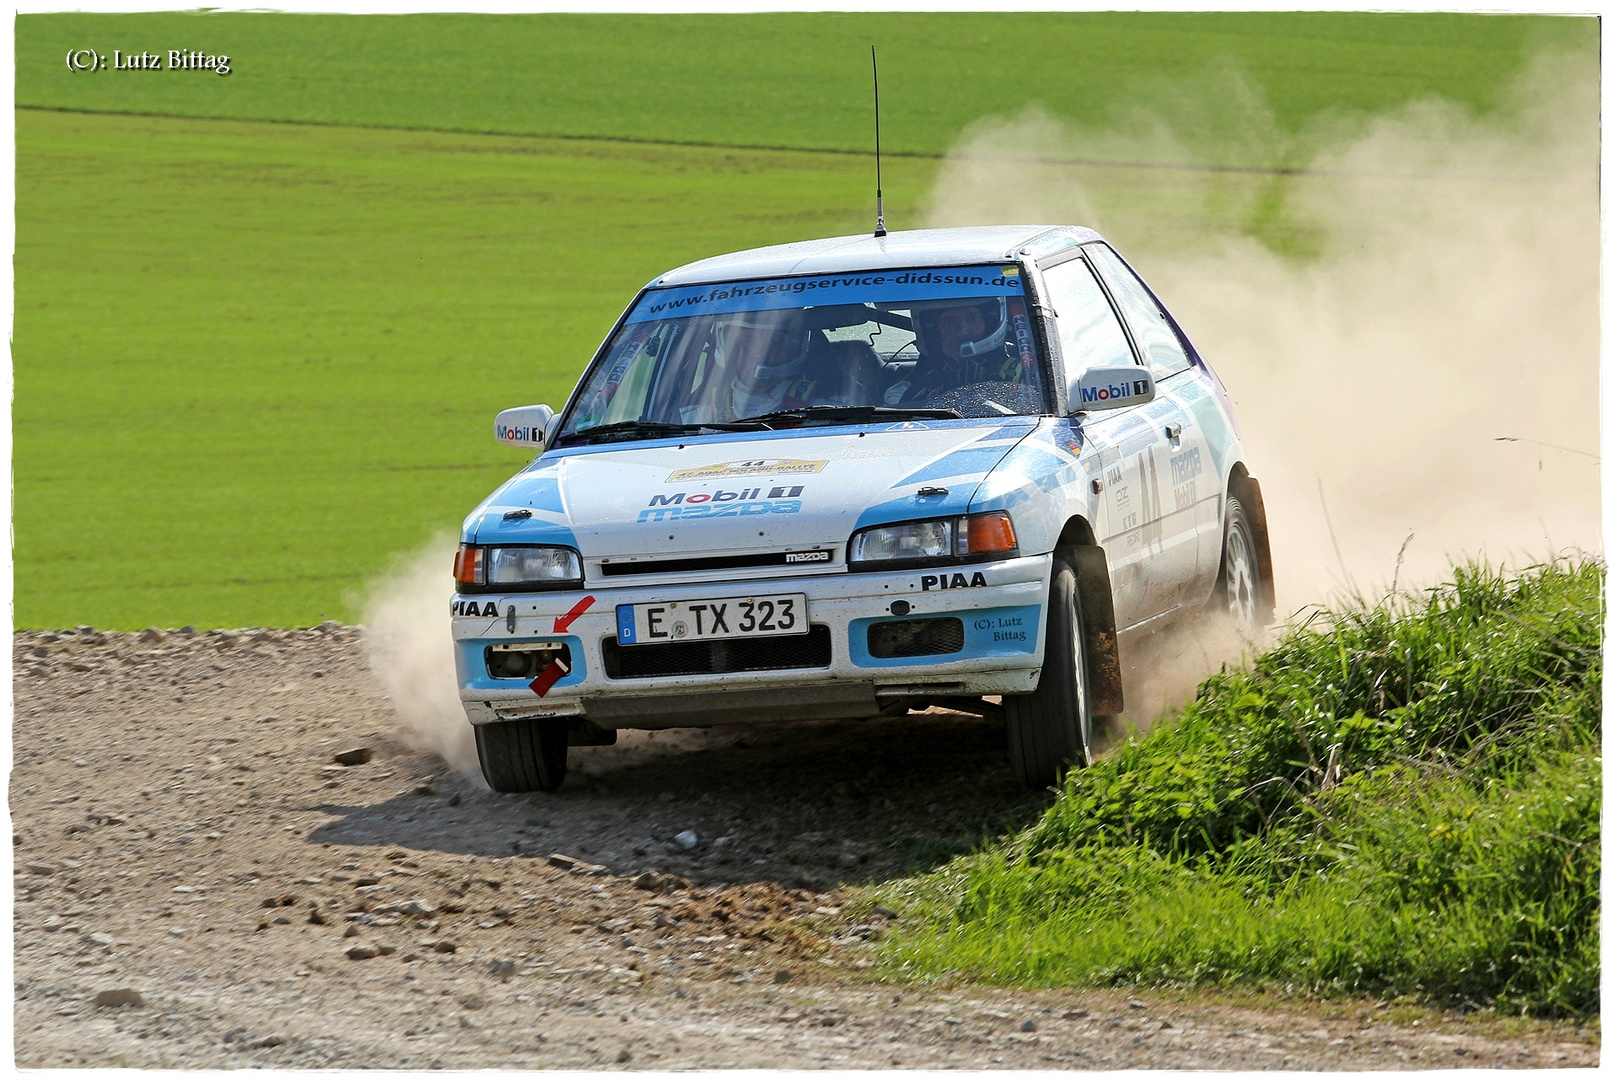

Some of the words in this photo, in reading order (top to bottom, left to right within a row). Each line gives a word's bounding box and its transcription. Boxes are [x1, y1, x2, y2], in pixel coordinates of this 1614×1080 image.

[649, 272, 1019, 314] www.fahrzeugservice-didssun.de
[1081, 382, 1131, 402] Mobil
[497, 425, 529, 441] Mobil
[741, 460, 765, 468] 44
[1106, 466, 1123, 487] PIAA
[648, 488, 761, 506] Mobil
[637, 500, 803, 523] mazda
[785, 551, 829, 563] mazda
[921, 572, 987, 591] PIAA
[452, 601, 499, 617] PIAA
[648, 607, 668, 638] E
[689, 603, 729, 635] TX
[738, 599, 795, 632] 323
[623, 628, 631, 638] D
